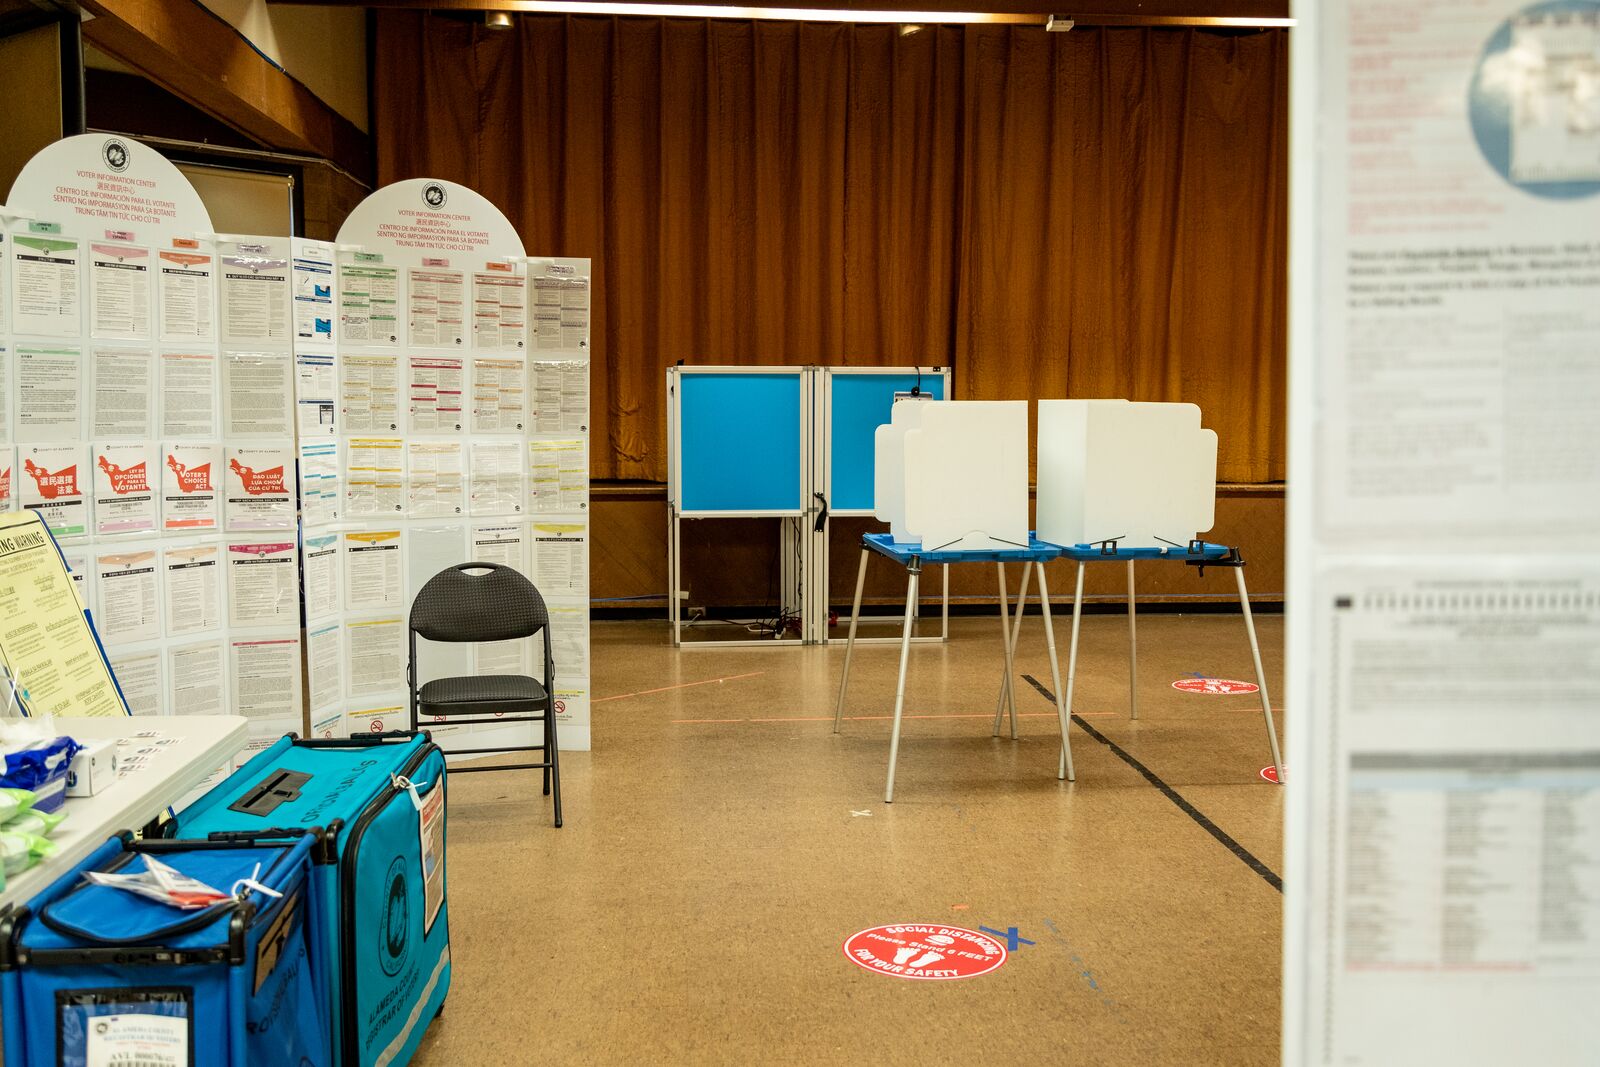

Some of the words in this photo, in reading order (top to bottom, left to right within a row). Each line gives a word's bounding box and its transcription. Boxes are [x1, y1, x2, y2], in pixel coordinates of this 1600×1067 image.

[77, 170, 96, 178] VOTER
[96, 173, 135, 185] INFORMATION
[136, 179, 156, 188] CENTER
[53, 194, 77, 204] SENTRO
[88, 200, 130, 211] IMPORMASYON
[131, 205, 144, 213] PARA
[153, 208, 176, 217] BOTANTE
[56, 186, 80, 196] CENTRO
[90, 191, 130, 203] INFORMACIÓN
[131, 196, 144, 204] PARA
[152, 199, 176, 209] VOTANTE
[75, 206, 95, 216] TRUNG
[96, 208, 108, 217] TÂM
[109, 211, 118, 219] TIN
[416, 211, 451, 220] INFORMATION
[407, 233, 446, 242] IMPORMASYON
[410, 226, 446, 235] INFORMACIÓN
[57, 485, 73, 494] 法案
[115, 480, 146, 491] VOTANTE
[13, 531, 44, 549] WARNING
[866, 933, 906, 945] Please
[908, 941, 945, 953] Stand
[957, 951, 993, 962] FEET
[885, 926, 936, 934] SOCIAL
[938, 928, 1000, 955] DISTANCING
[854, 948, 876, 961] FOR
[868, 958, 905, 973] YOUR
[904, 969, 958, 977] SAFETY
